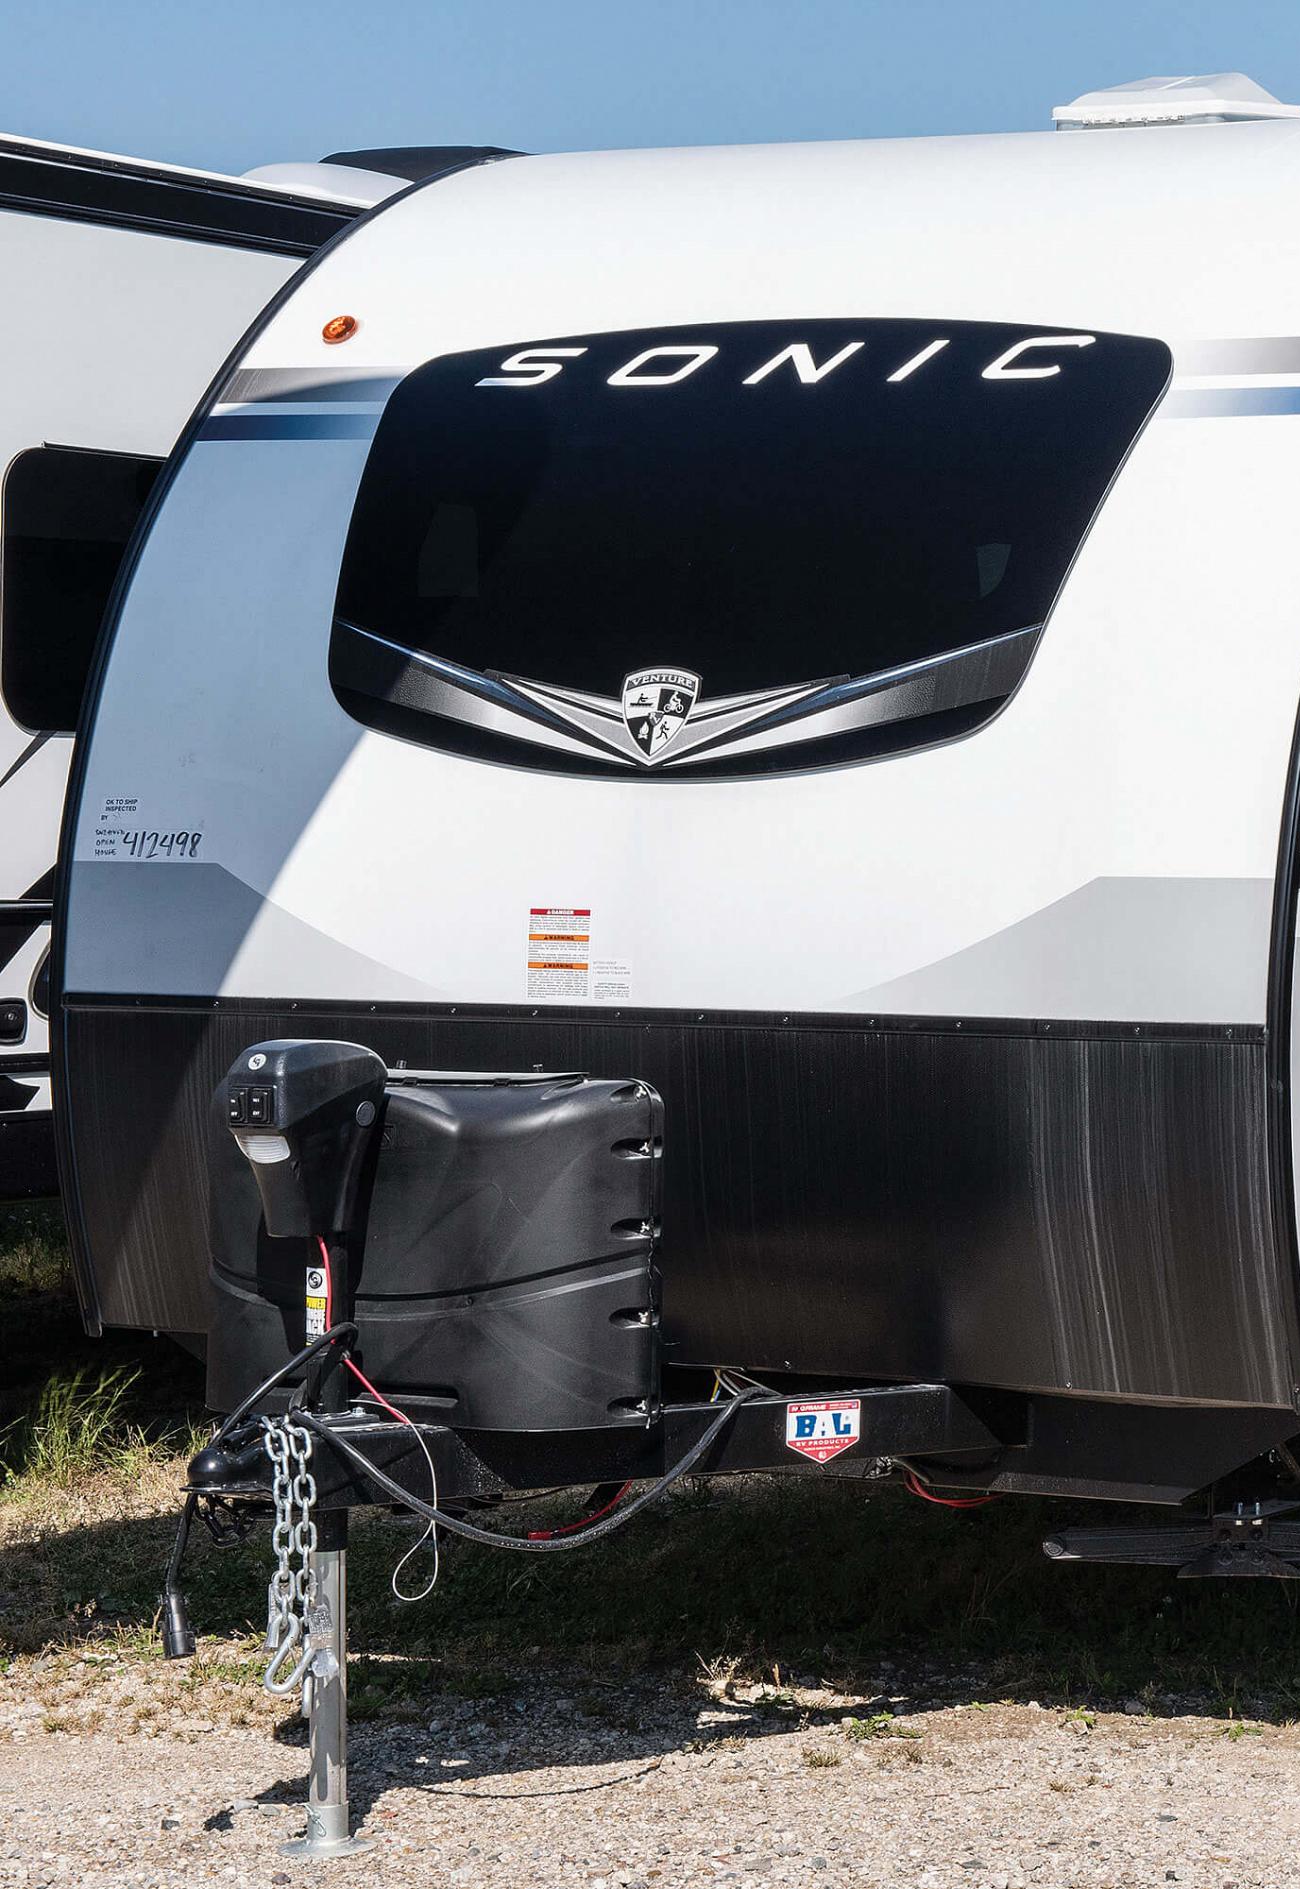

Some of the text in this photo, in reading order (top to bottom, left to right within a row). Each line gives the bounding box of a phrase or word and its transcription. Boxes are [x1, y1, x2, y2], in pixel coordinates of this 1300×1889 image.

[475, 335, 1097, 387] SONIC
[631, 673, 693, 688] VENTURE
[122, 830, 203, 859] 412498
